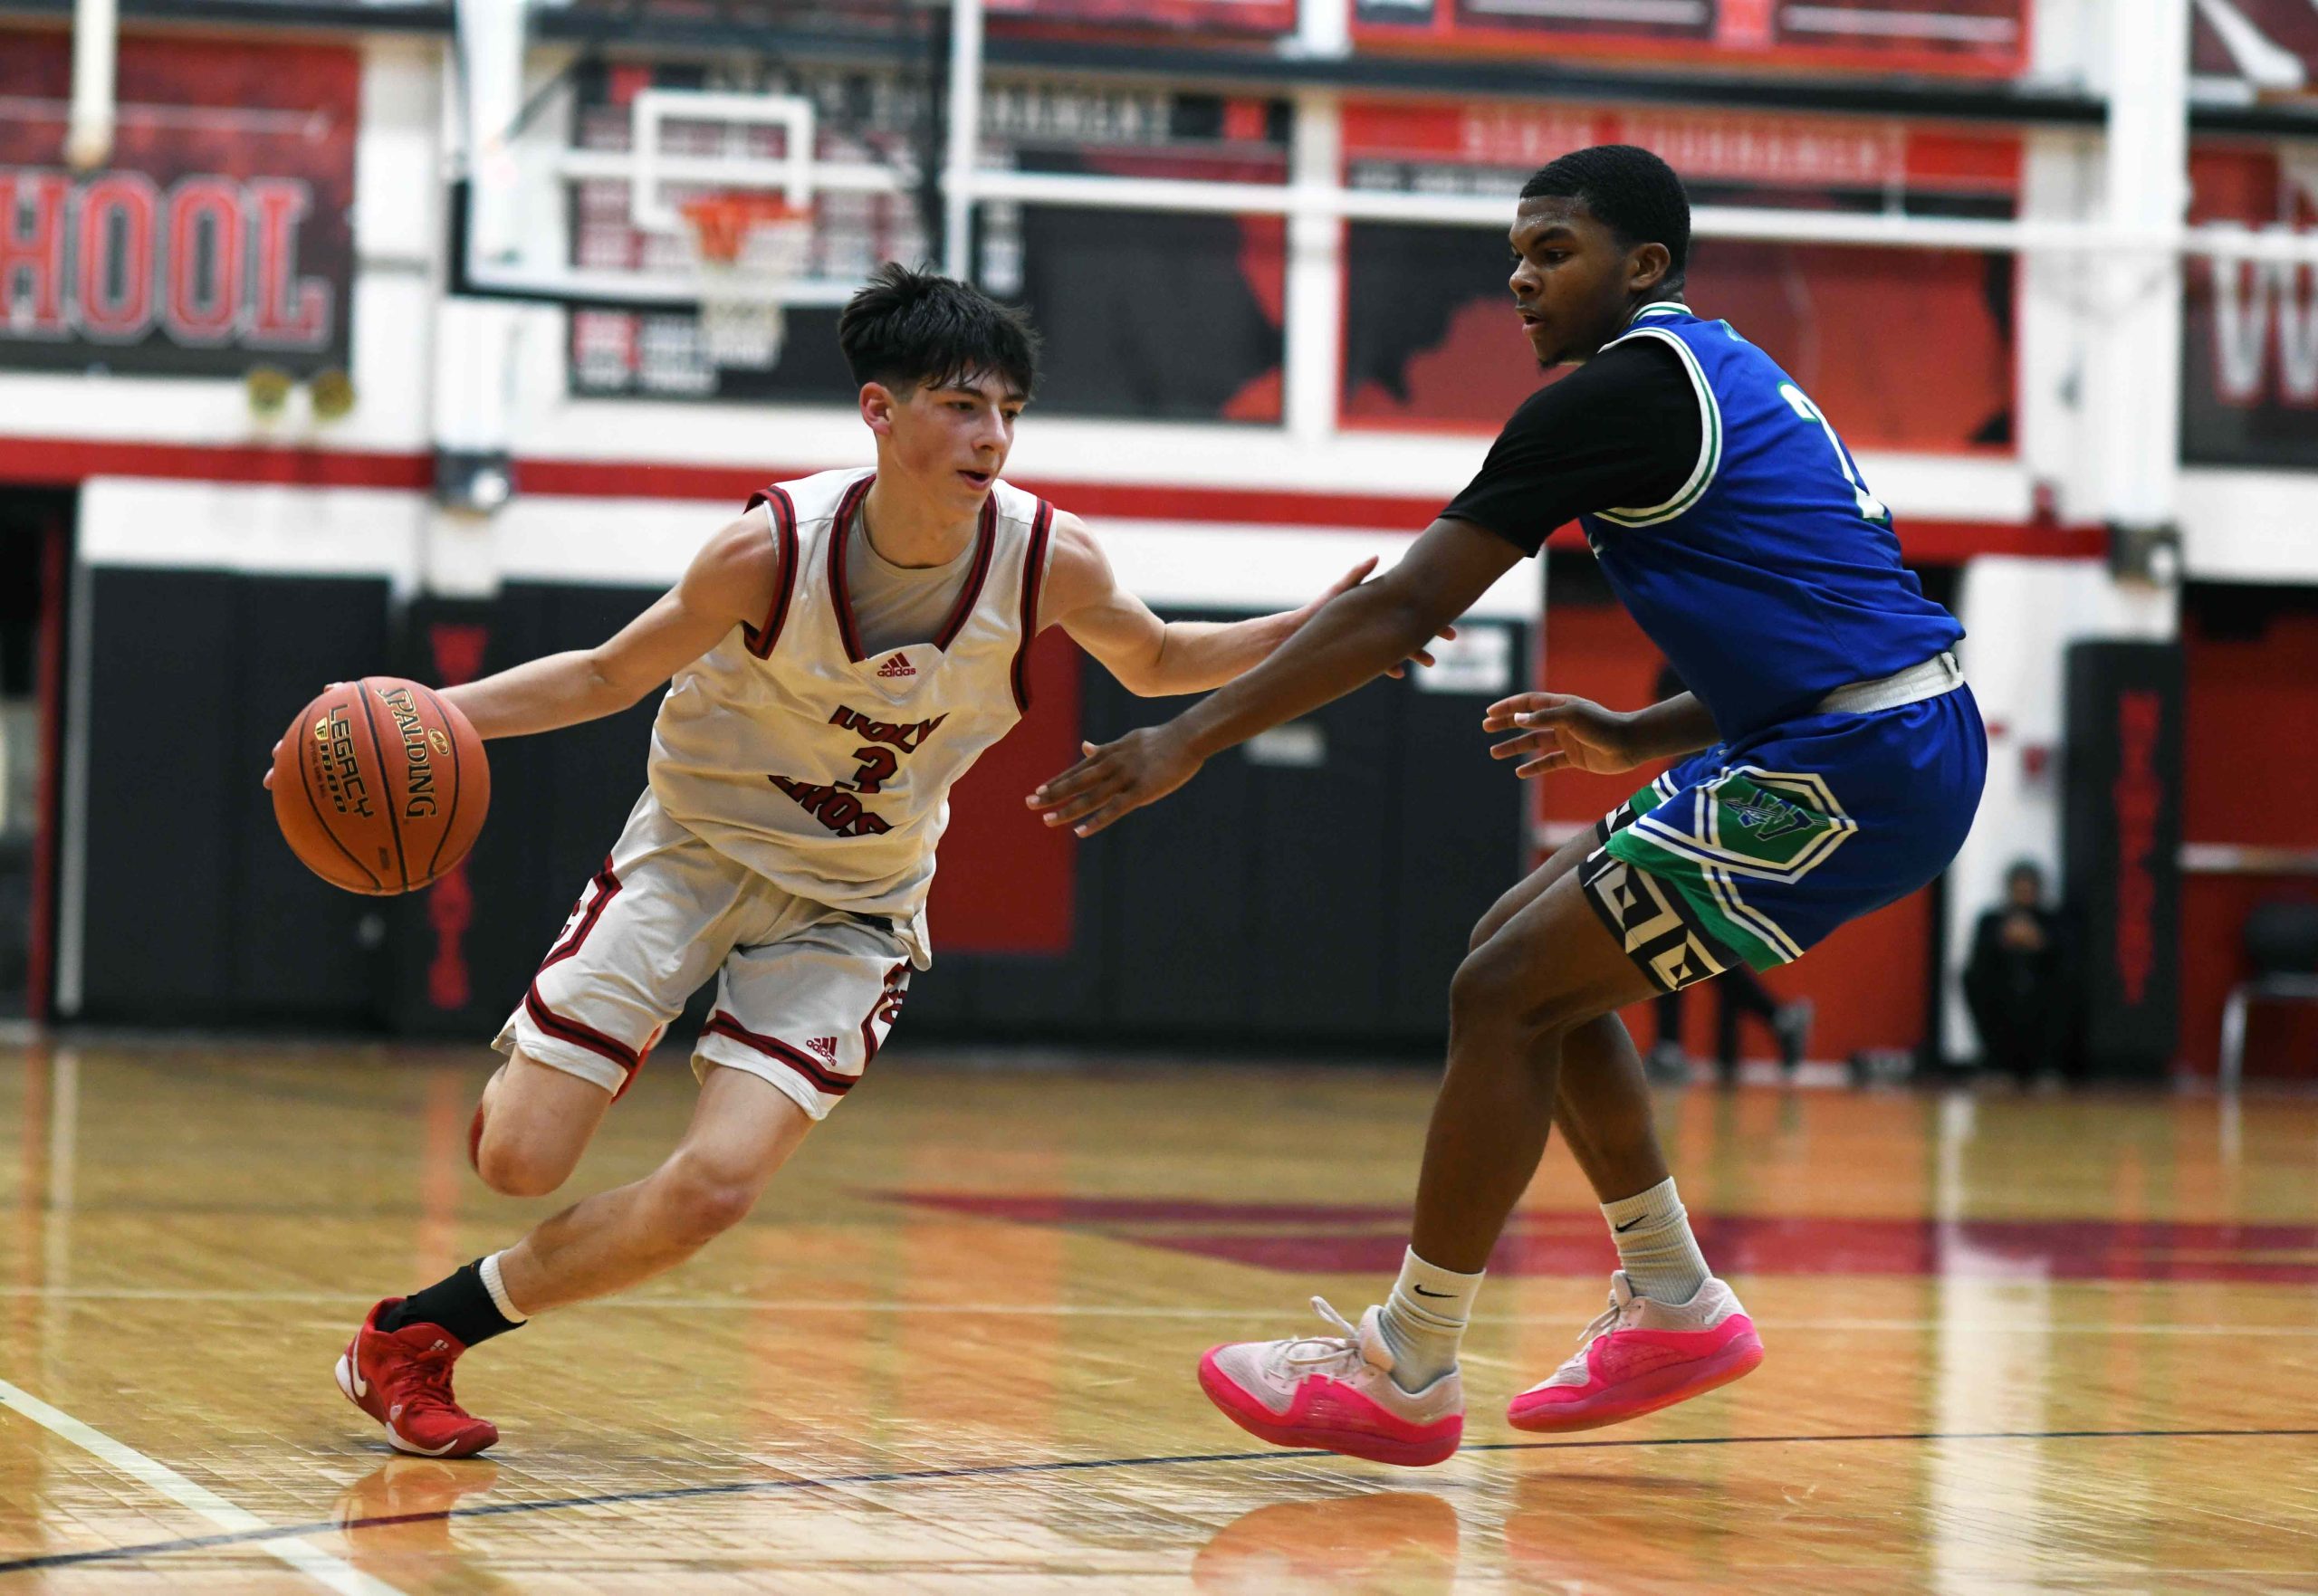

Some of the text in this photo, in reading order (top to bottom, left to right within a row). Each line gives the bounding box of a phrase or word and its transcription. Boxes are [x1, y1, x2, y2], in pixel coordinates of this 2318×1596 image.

[0, 169, 331, 349] HOOL
[877, 667, 916, 677] adidas
[319, 743, 348, 813] 1000
[330, 703, 374, 819] LEGACY
[375, 687, 437, 818] SPALDING
[806, 1039, 838, 1066] adidas
